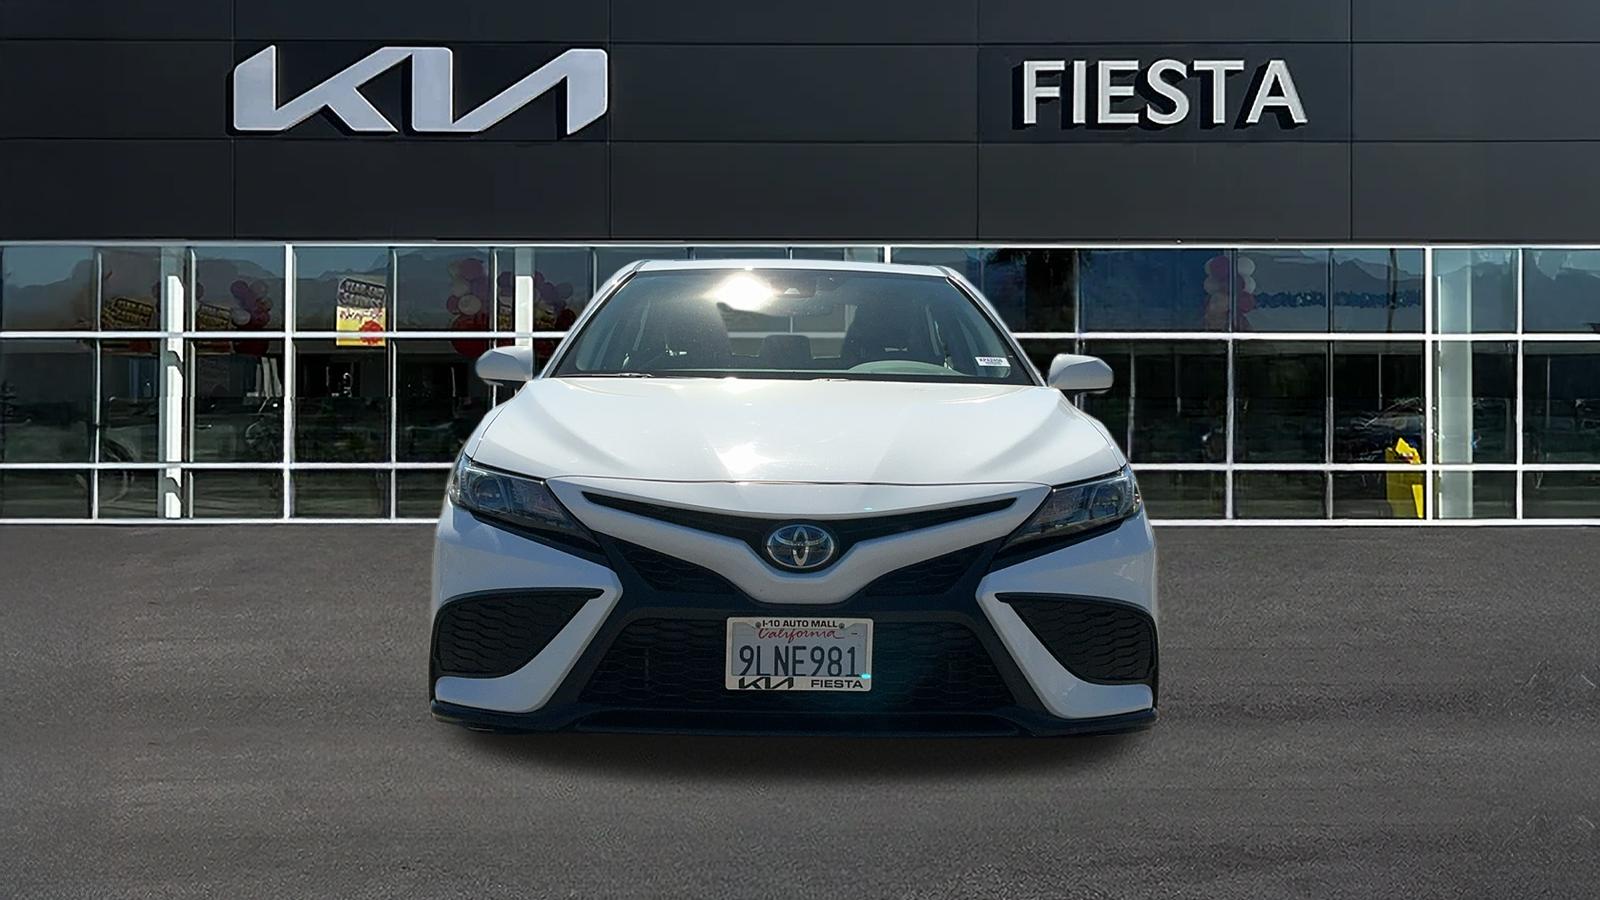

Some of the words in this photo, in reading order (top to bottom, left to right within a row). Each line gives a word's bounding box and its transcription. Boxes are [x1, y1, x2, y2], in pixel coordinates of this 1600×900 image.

[233, 44, 608, 135] KIA
[1023, 58, 1308, 125] FIESTA
[762, 619, 780, 628] I-10
[782, 619, 809, 628] AUTO
[810, 620, 838, 628] MALL
[758, 628, 845, 644] California
[739, 645, 861, 677] 9LNE981
[738, 677, 794, 690] KIA
[810, 679, 864, 689] FIESTA
